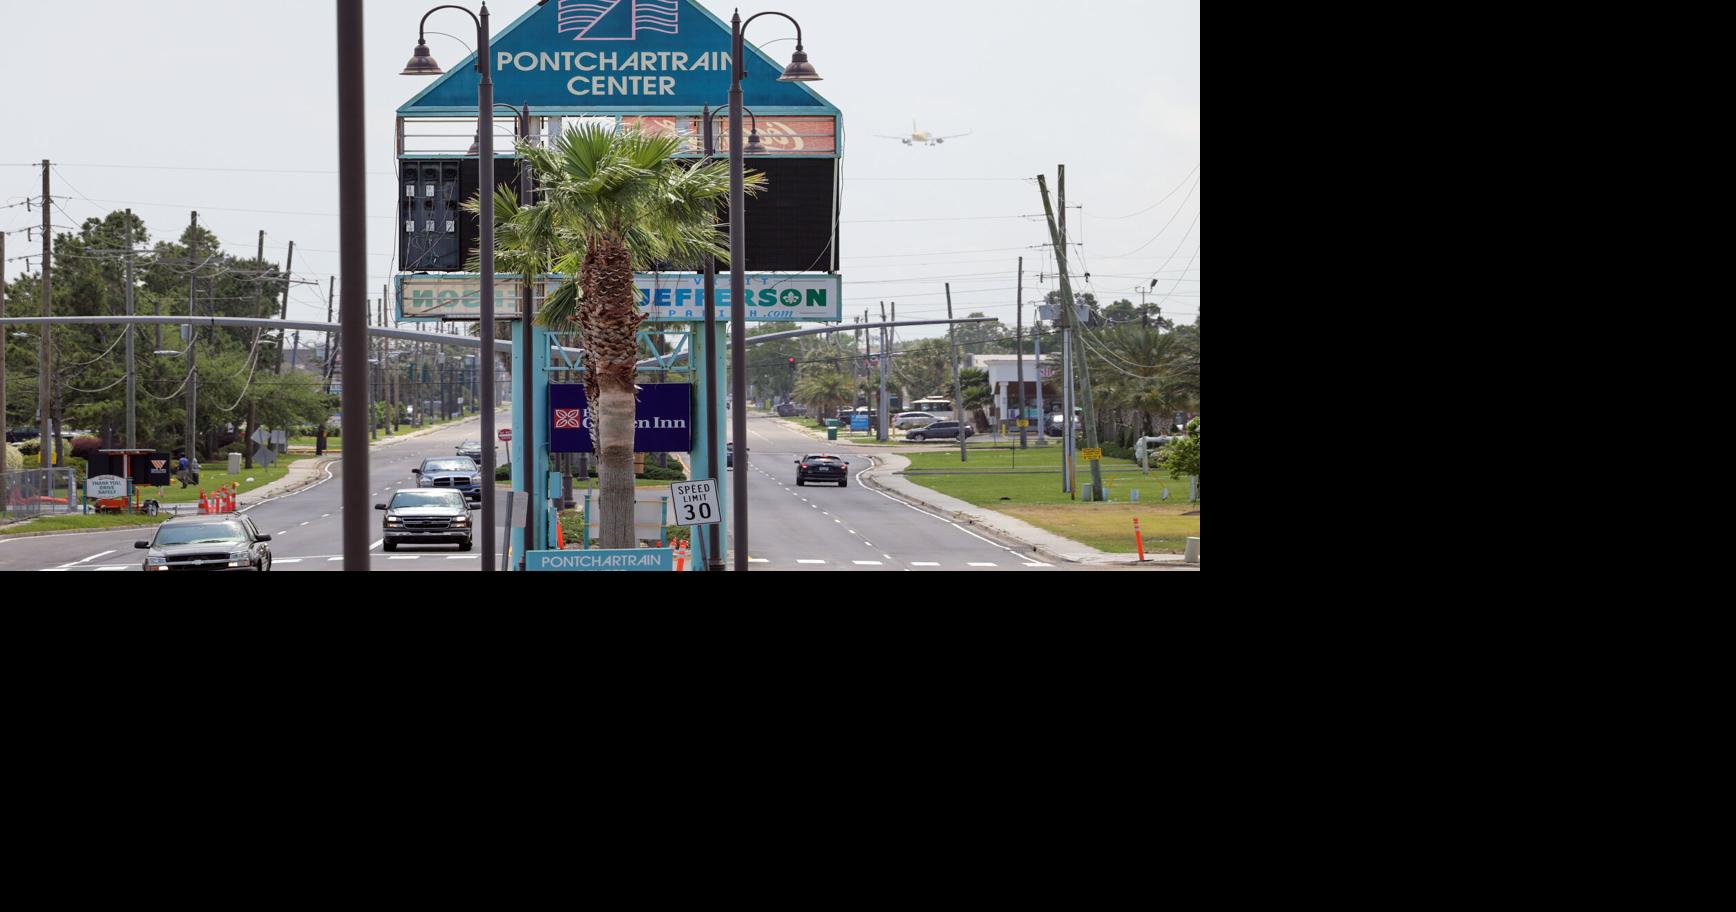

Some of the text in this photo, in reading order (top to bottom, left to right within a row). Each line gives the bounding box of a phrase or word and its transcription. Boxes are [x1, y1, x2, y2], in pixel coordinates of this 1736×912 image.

[497, 51, 733, 71] PONTCHARTRAIN
[566, 76, 676, 96] CENTER
[653, 416, 686, 429] Inn
[677, 484, 710, 495] SPEED
[683, 494, 707, 503] LIMIT
[683, 503, 711, 521] 30
[541, 554, 661, 568] PONTCHARTRAIN
